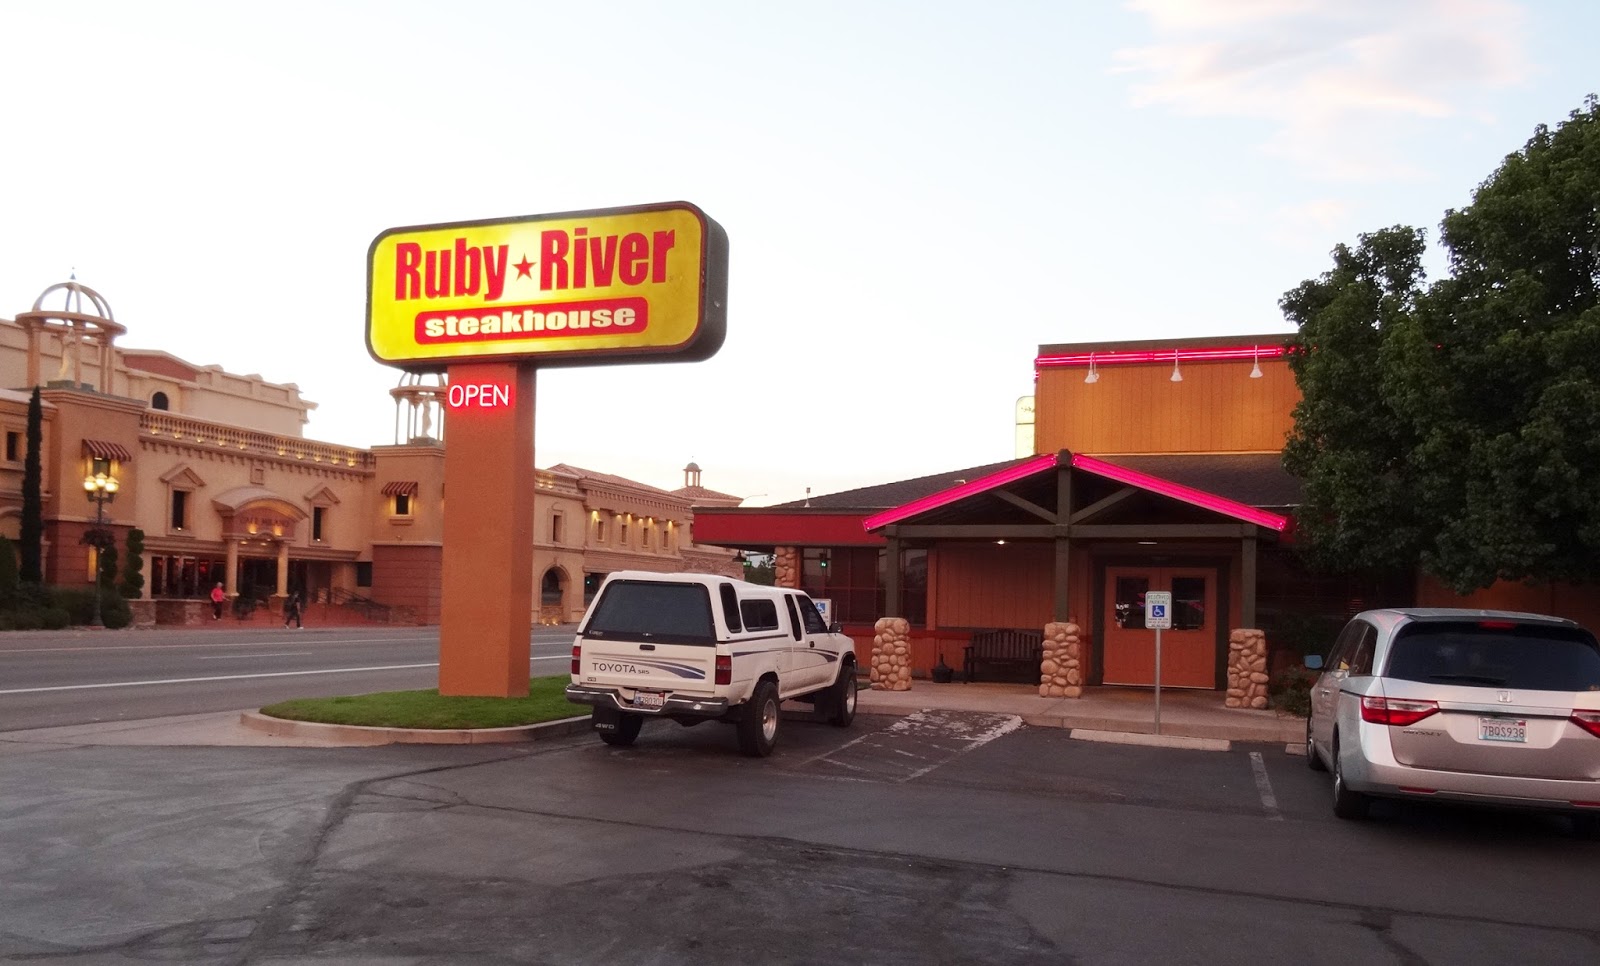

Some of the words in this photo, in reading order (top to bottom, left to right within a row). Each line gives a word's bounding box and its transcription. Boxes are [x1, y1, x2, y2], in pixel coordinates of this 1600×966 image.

[395, 237, 509, 301] Ruby
[540, 227, 675, 290] River
[425, 306, 636, 337] steakhouse
[449, 384, 510, 407] OPEN
[592, 662, 636, 674] TOYOTA
[595, 722, 615, 730] 4WD
[1482, 726, 1525, 738] 7BQS938
